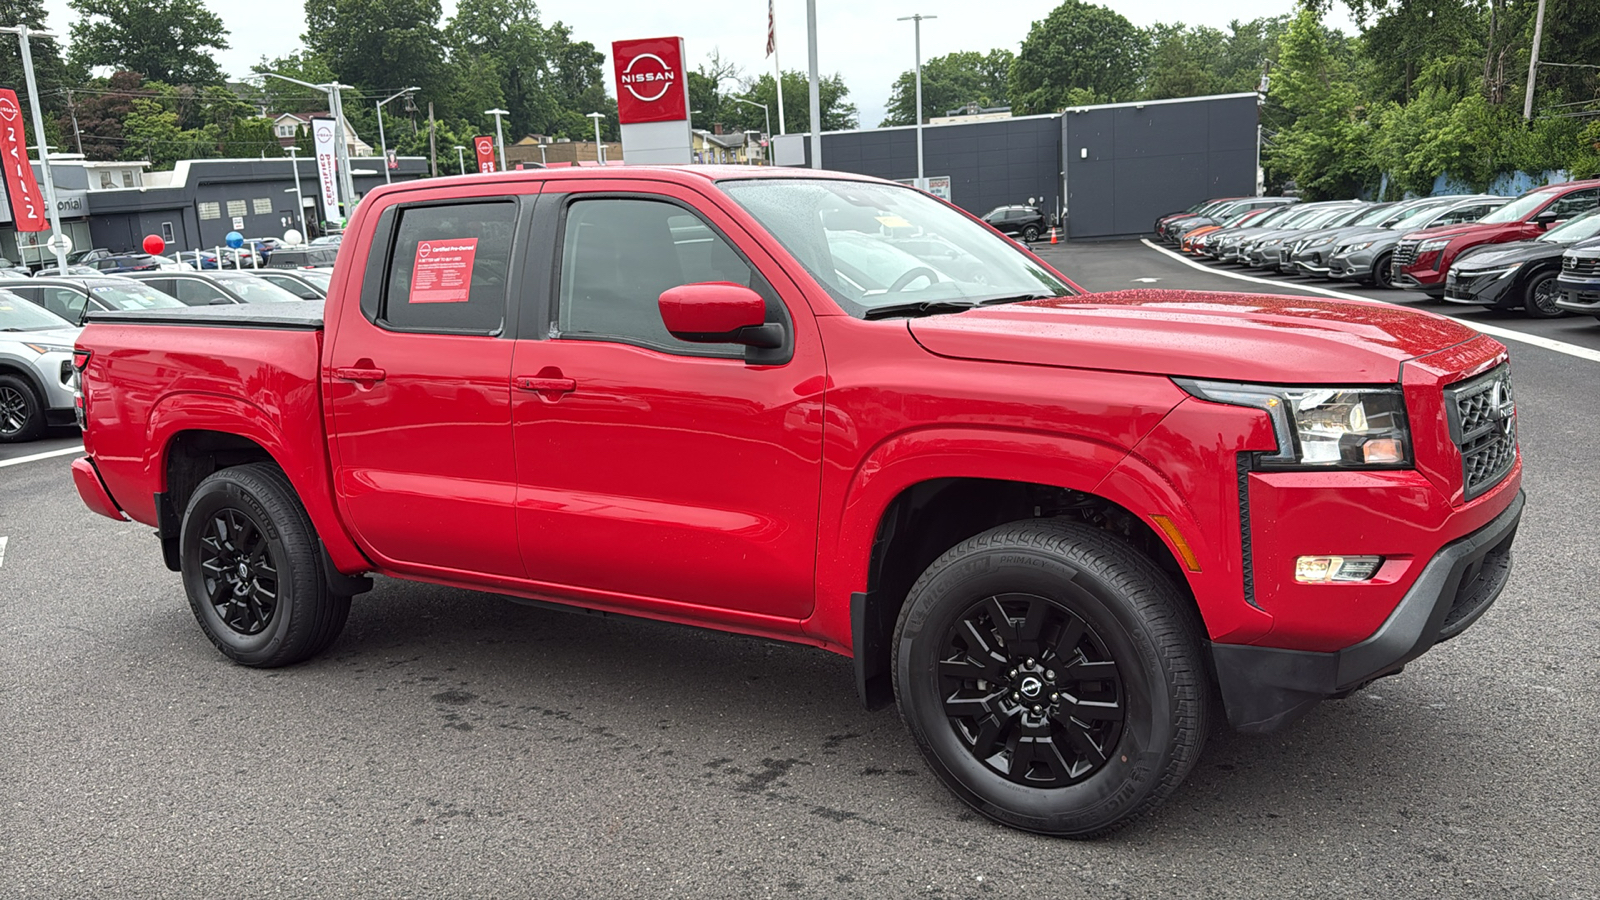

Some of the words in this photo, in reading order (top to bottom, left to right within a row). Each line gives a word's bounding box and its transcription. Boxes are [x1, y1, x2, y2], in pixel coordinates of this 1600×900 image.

[621, 71, 675, 84] NISSAN
[319, 153, 333, 206] CERTIFIED
[242, 494, 277, 538] MICHELIN
[1000, 555, 1048, 568] PRIMACY
